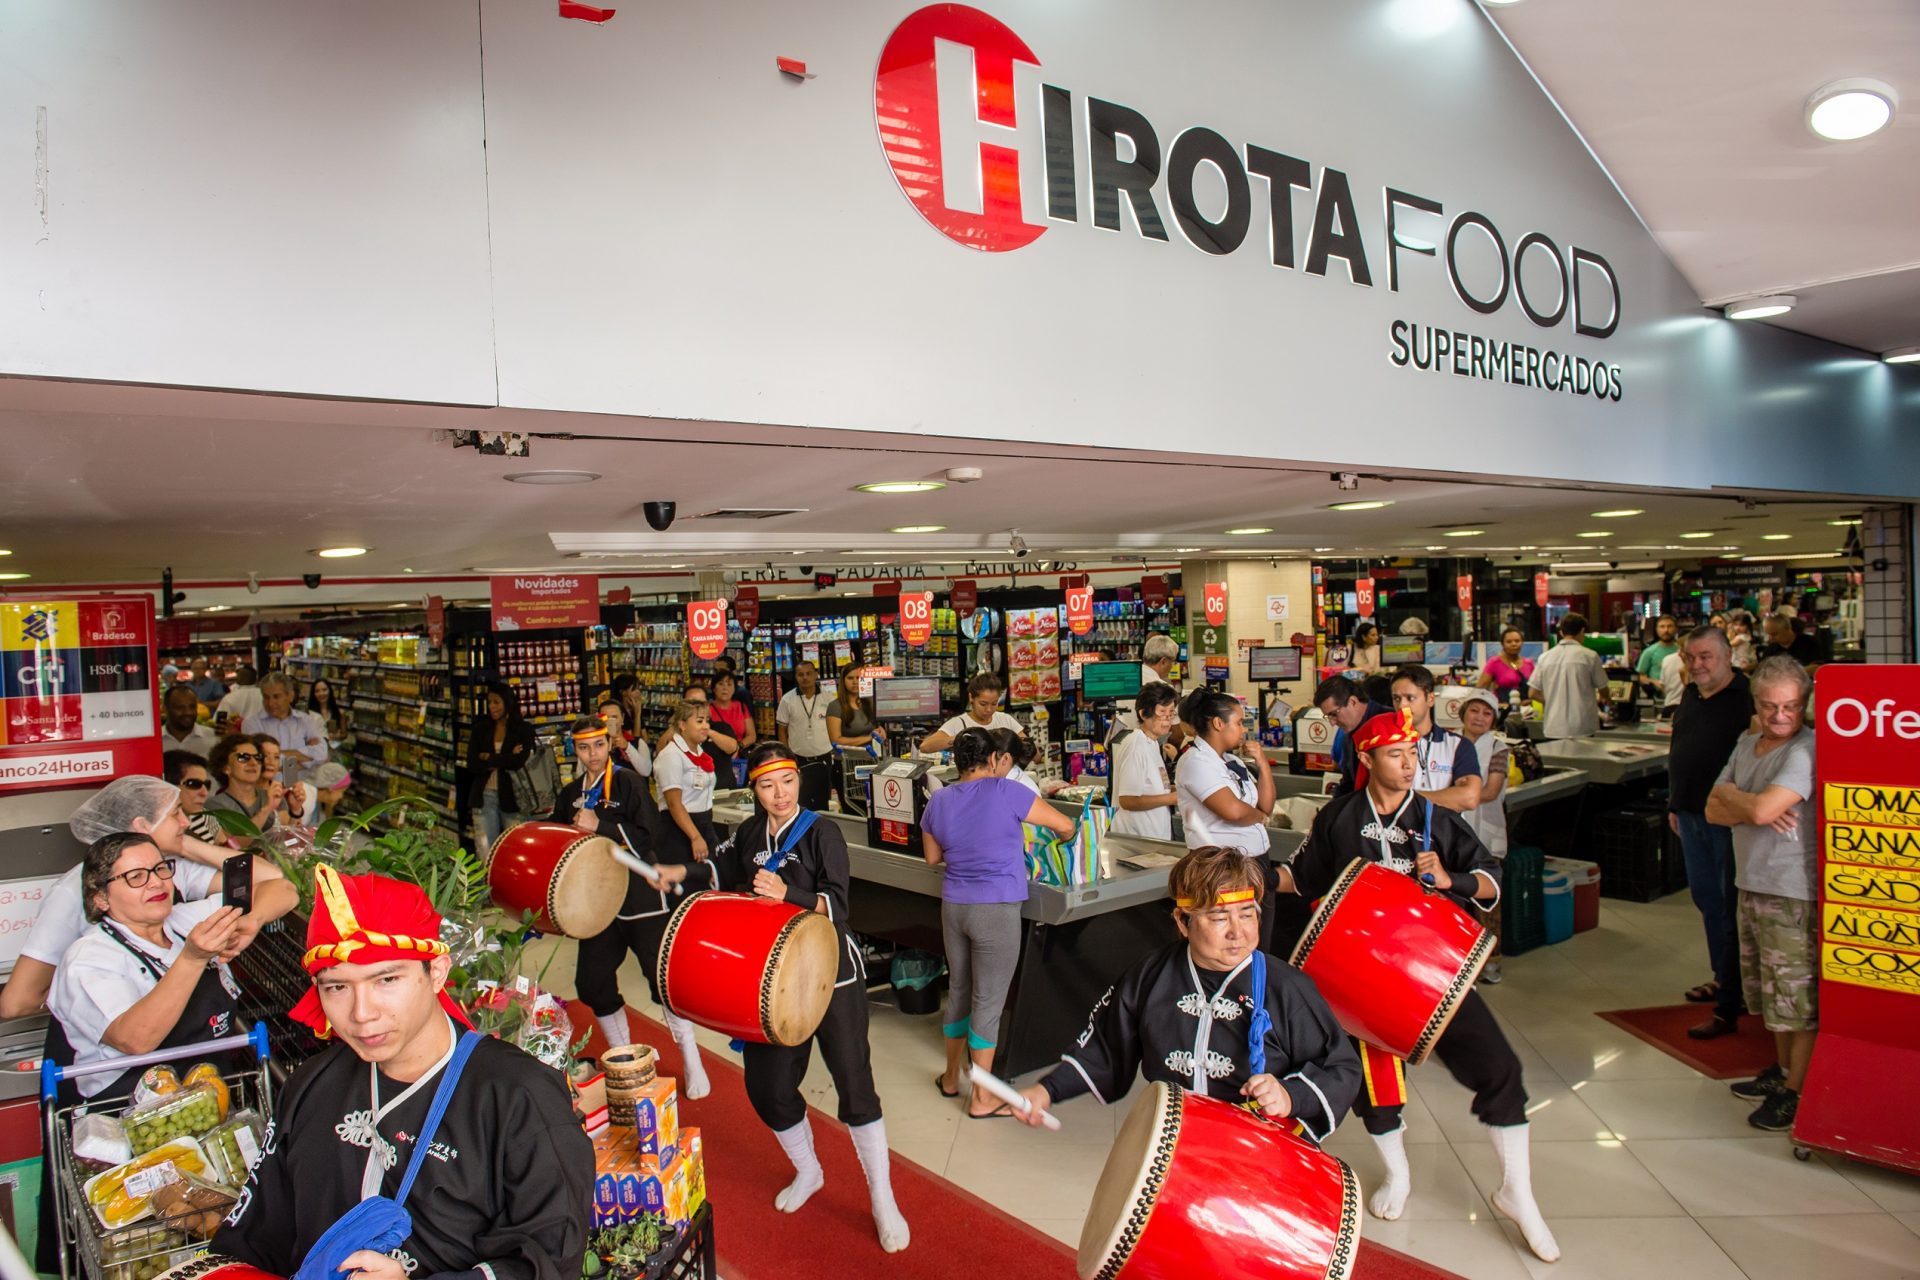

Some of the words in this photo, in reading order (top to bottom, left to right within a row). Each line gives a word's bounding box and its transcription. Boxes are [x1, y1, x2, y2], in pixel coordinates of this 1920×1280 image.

[875, 3, 1373, 286] HIROTA
[1383, 186, 1622, 339] FOOD
[1388, 319, 1622, 402] SUPERMERCADOS
[515, 578, 579, 590] Novidades
[1358, 590, 1372, 604] 05
[1459, 587, 1471, 599] 04
[904, 600, 928, 619] 08
[1070, 594, 1089, 611] 07
[1207, 597, 1224, 613] 06
[693, 608, 721, 631] 09
[92, 631, 136, 641] Bradesco
[90, 665, 122, 676] HSBC
[99, 711, 110, 719] 40
[113, 710, 145, 718] bancos
[1826, 698, 1920, 740] Ofe
